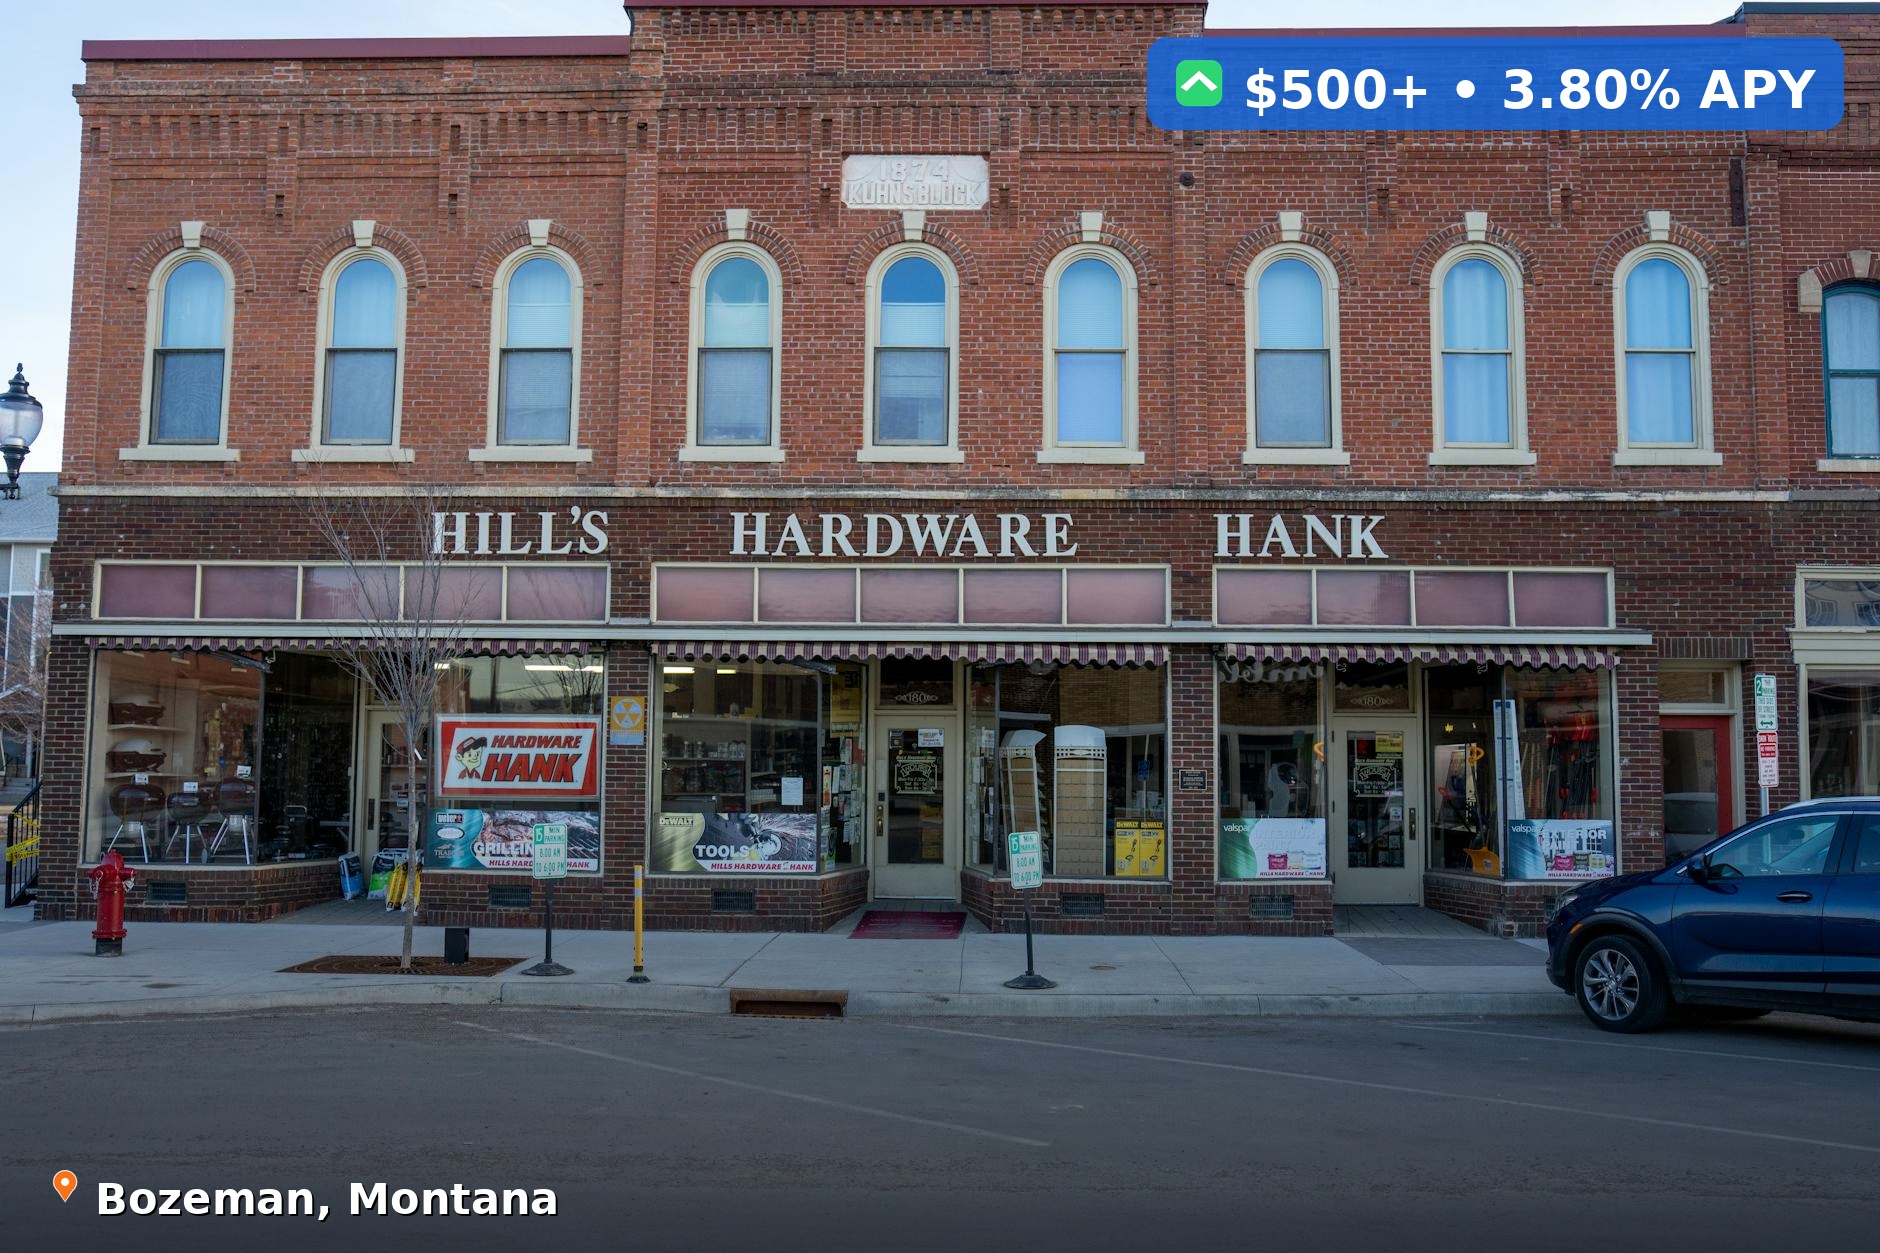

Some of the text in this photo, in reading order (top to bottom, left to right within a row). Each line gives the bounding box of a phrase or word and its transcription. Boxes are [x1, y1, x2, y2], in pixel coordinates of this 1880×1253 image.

[880, 158, 948, 182] 1874
[432, 506, 1389, 559] HILL'S HARDWARE HANK
[1756, 679, 1762, 694] 2
[491, 735, 583, 749] HARDWARE
[481, 753, 583, 783] HANK
[535, 827, 543, 842] 15
[1223, 823, 1249, 834] valspa
[473, 841, 533, 856] GRILLIN
[695, 844, 750, 858] TOOLS
[1012, 836, 1019, 851] 15
[552, 847, 561, 857] AM
[557, 861, 565, 871] PM
[789, 863, 814, 871] HANK
